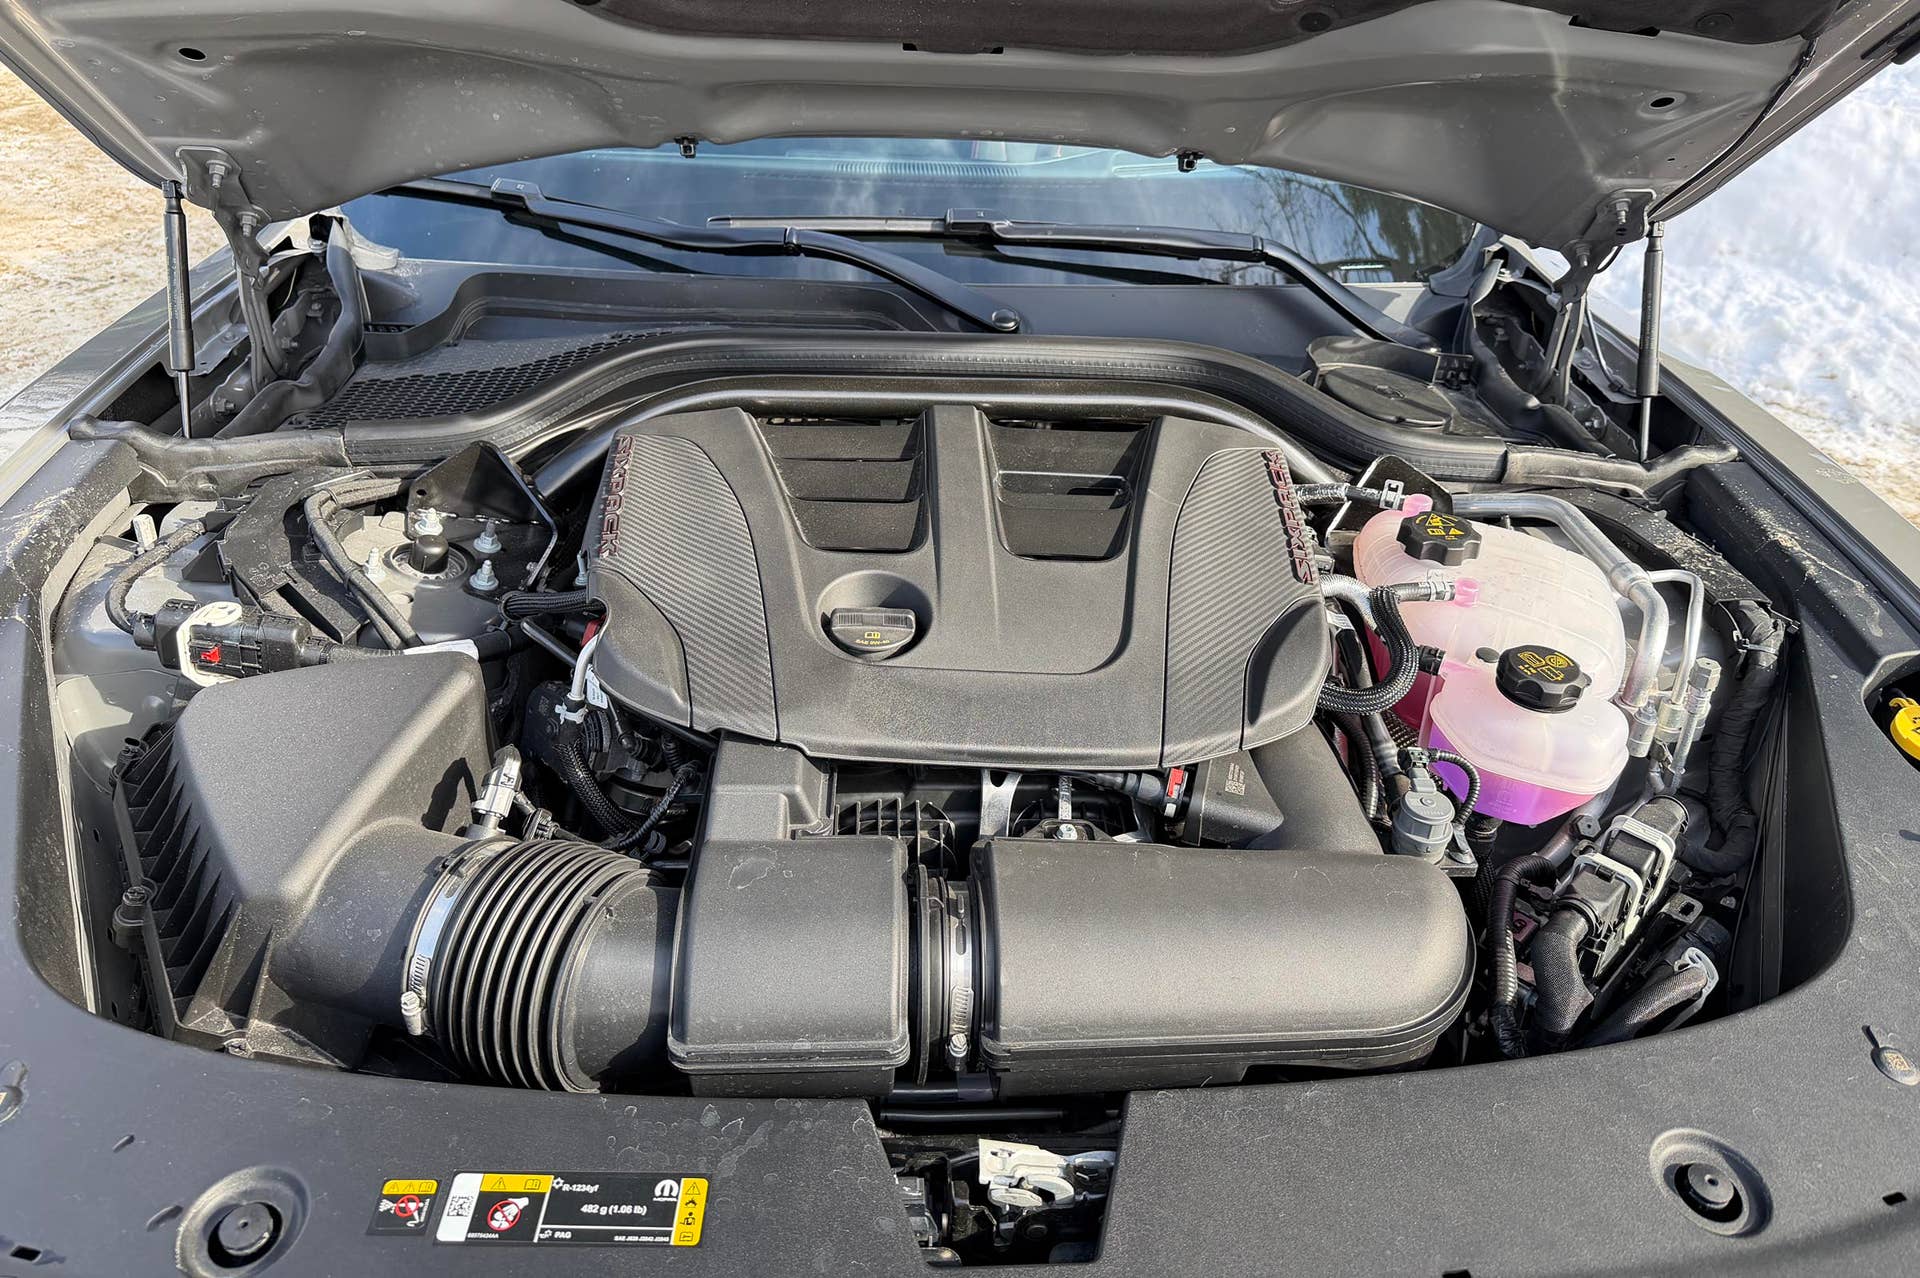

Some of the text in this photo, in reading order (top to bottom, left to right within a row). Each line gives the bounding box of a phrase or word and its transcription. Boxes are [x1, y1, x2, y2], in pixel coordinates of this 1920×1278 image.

[562, 1183, 600, 1194] R-1234yf
[580, 1203, 648, 1216] 482 g (1.06 lb)
[554, 1231, 572, 1239] PAG
